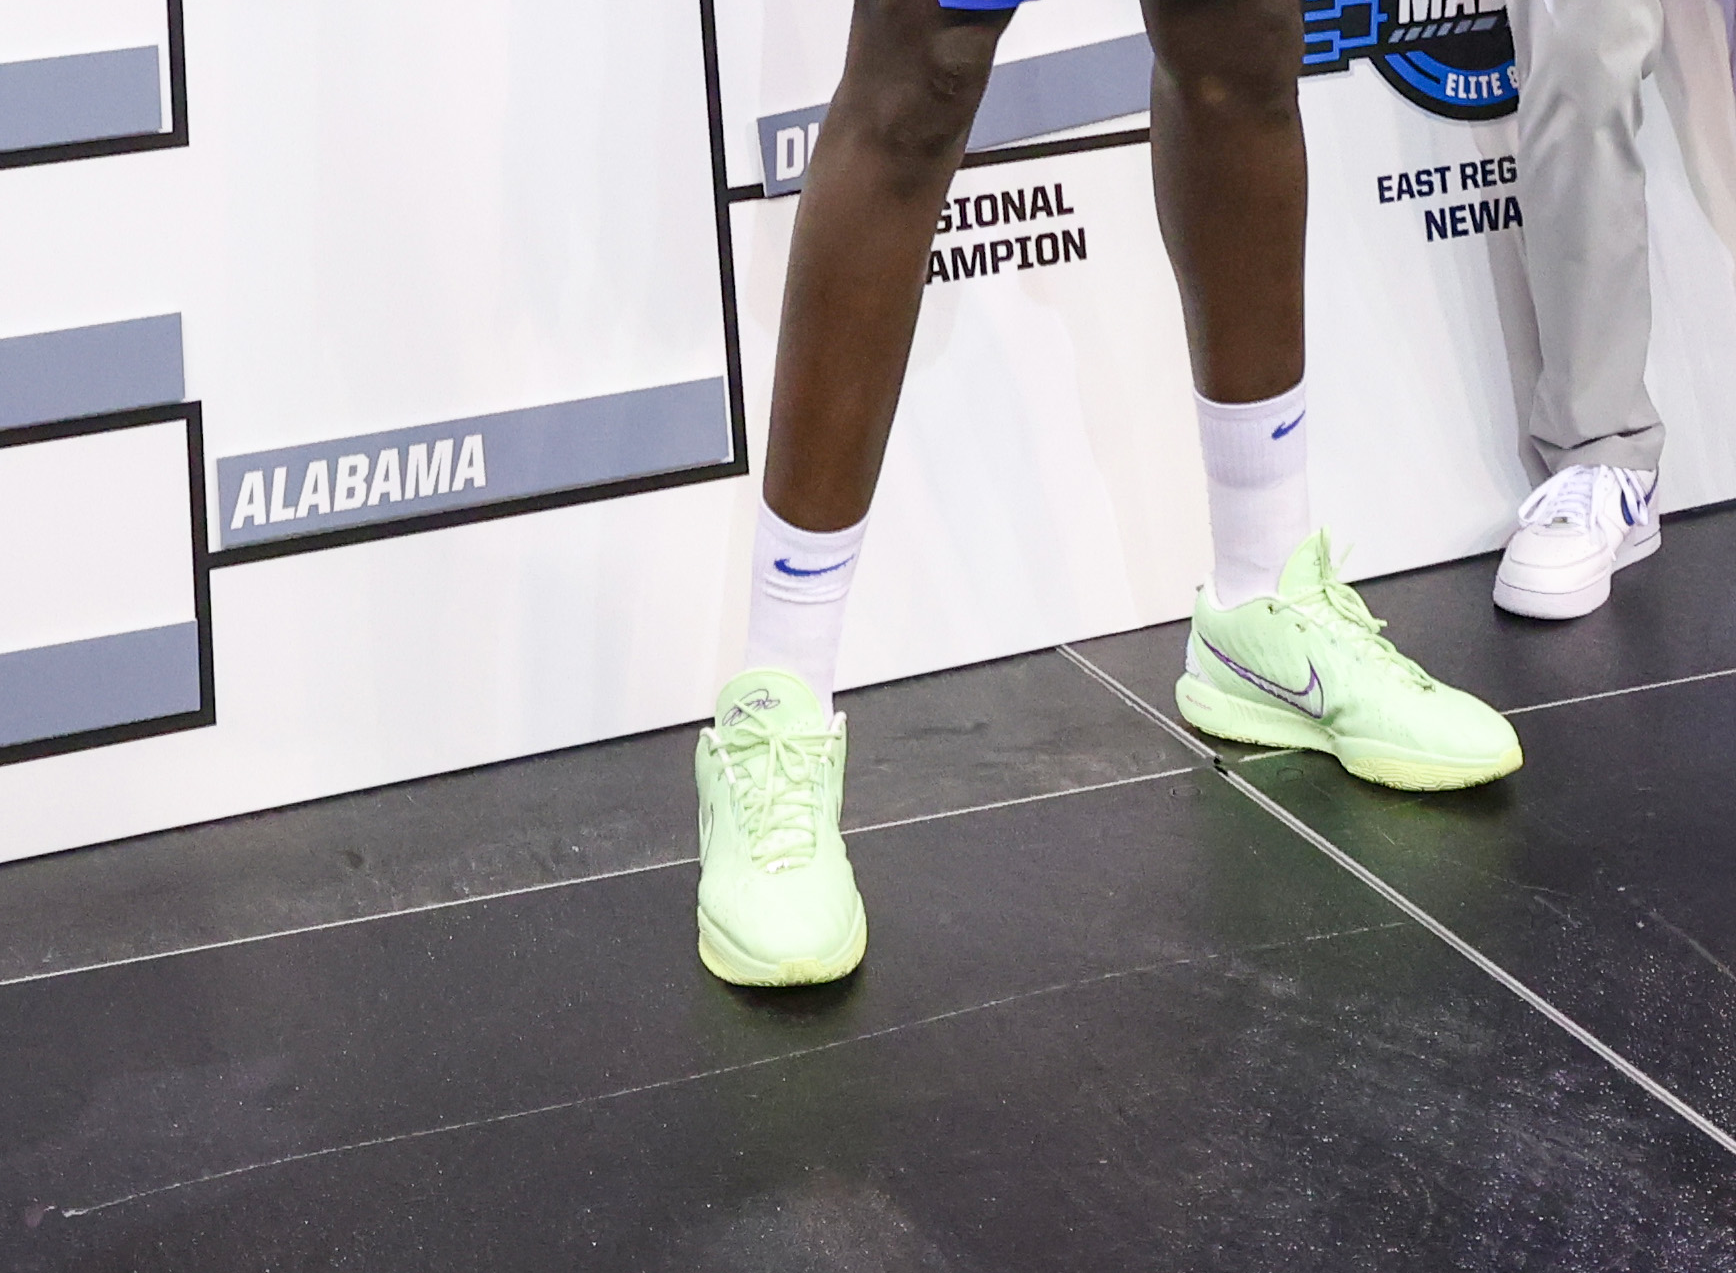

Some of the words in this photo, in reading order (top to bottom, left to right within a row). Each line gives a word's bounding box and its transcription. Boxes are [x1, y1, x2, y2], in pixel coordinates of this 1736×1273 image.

[1445, 70, 1502, 101] ELITE
[1377, 166, 1451, 204] EAST
[1425, 195, 1523, 242] NEWA
[925, 227, 1087, 285] AMPION
[230, 434, 487, 530] ALABAMA
